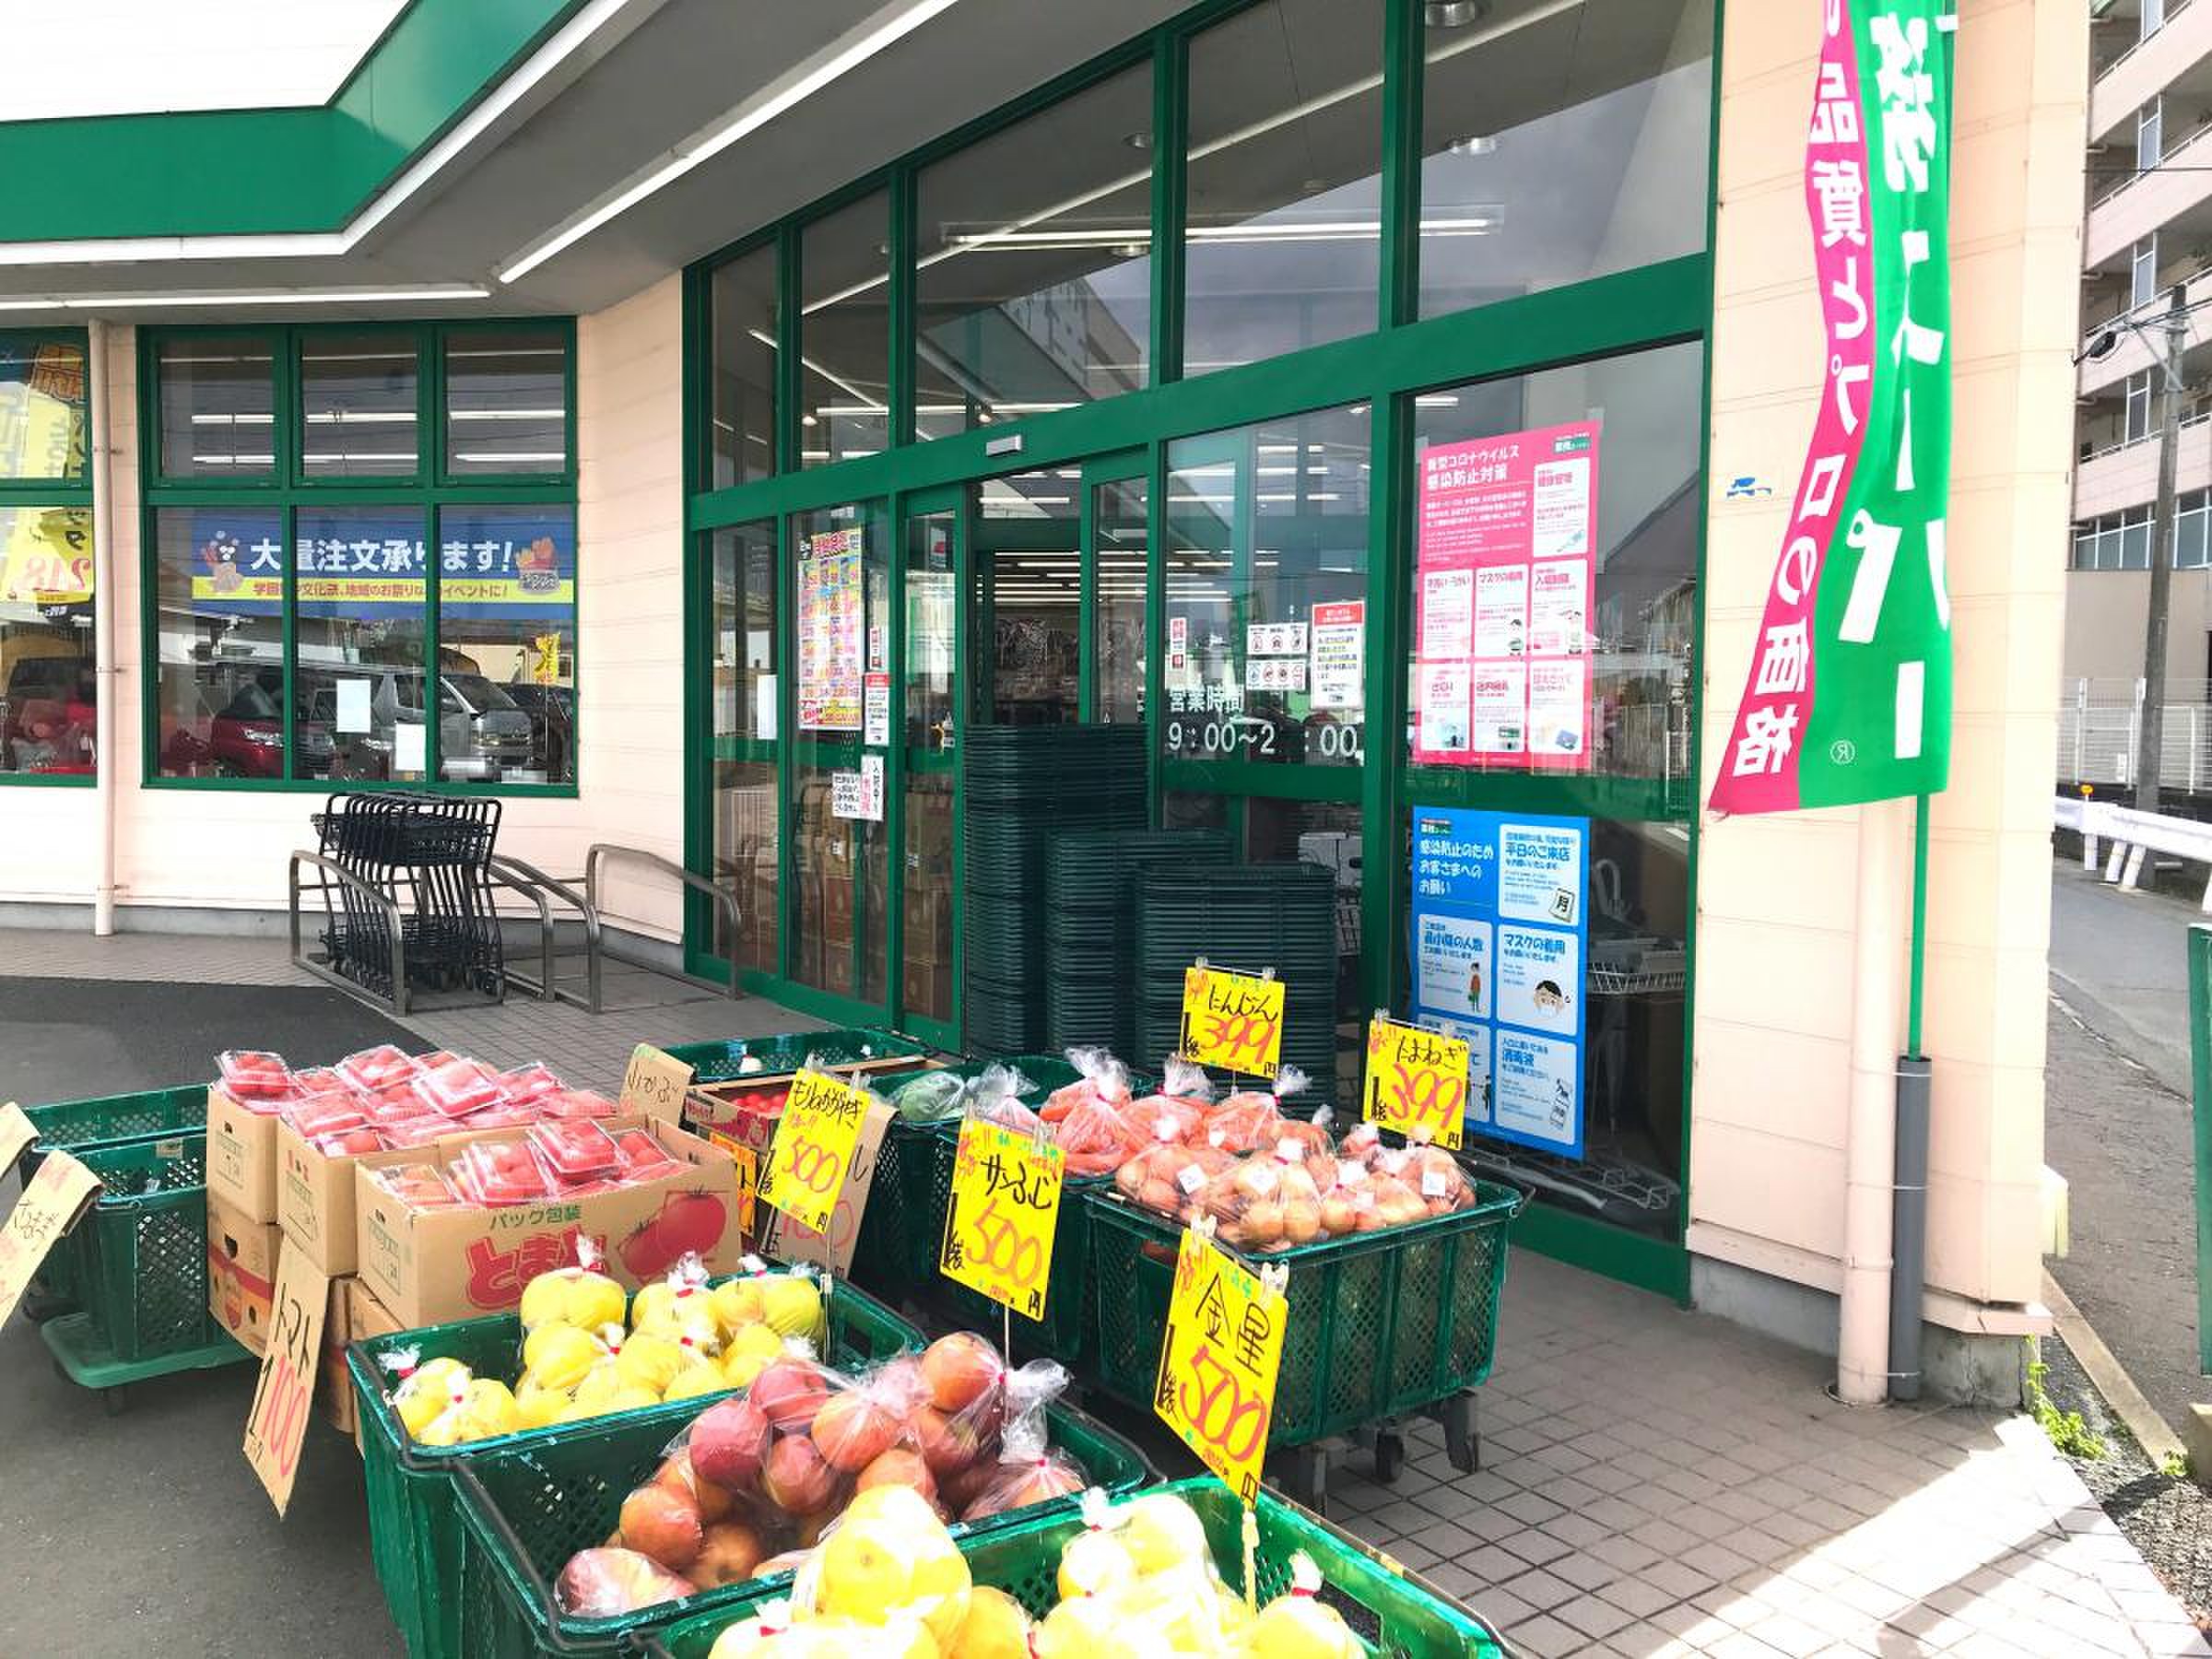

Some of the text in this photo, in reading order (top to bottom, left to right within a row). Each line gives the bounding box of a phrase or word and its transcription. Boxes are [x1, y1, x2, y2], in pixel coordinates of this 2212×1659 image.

[1169, 685, 1245, 713] 営業時間
[1505, 841, 1571, 862] 平日のご来店
[1418, 878, 1452, 896] お願い
[1556, 895, 1570, 912] 月
[1503, 934, 1566, 955] マスクの着用
[1208, 984, 1278, 1022] にんじん
[1201, 1014, 1276, 1064] 399
[1396, 1035, 1468, 1071] たまねぎ
[1264, 1062, 1277, 1076] 円
[1389, 1063, 1464, 1130] 399
[1447, 1131, 1461, 1148] 円
[782, 1135, 841, 1194] 500
[980, 1153, 1053, 1210] サンふじ
[489, 1204, 583, 1230] パック包装
[965, 1197, 1042, 1288] 500
[1028, 1288, 1041, 1317] 円
[1194, 1271, 1271, 1378] 金星
[262, 1356, 309, 1477] 100
[1179, 1344, 1267, 1463] 500
[1241, 1471, 1259, 1508] 円
